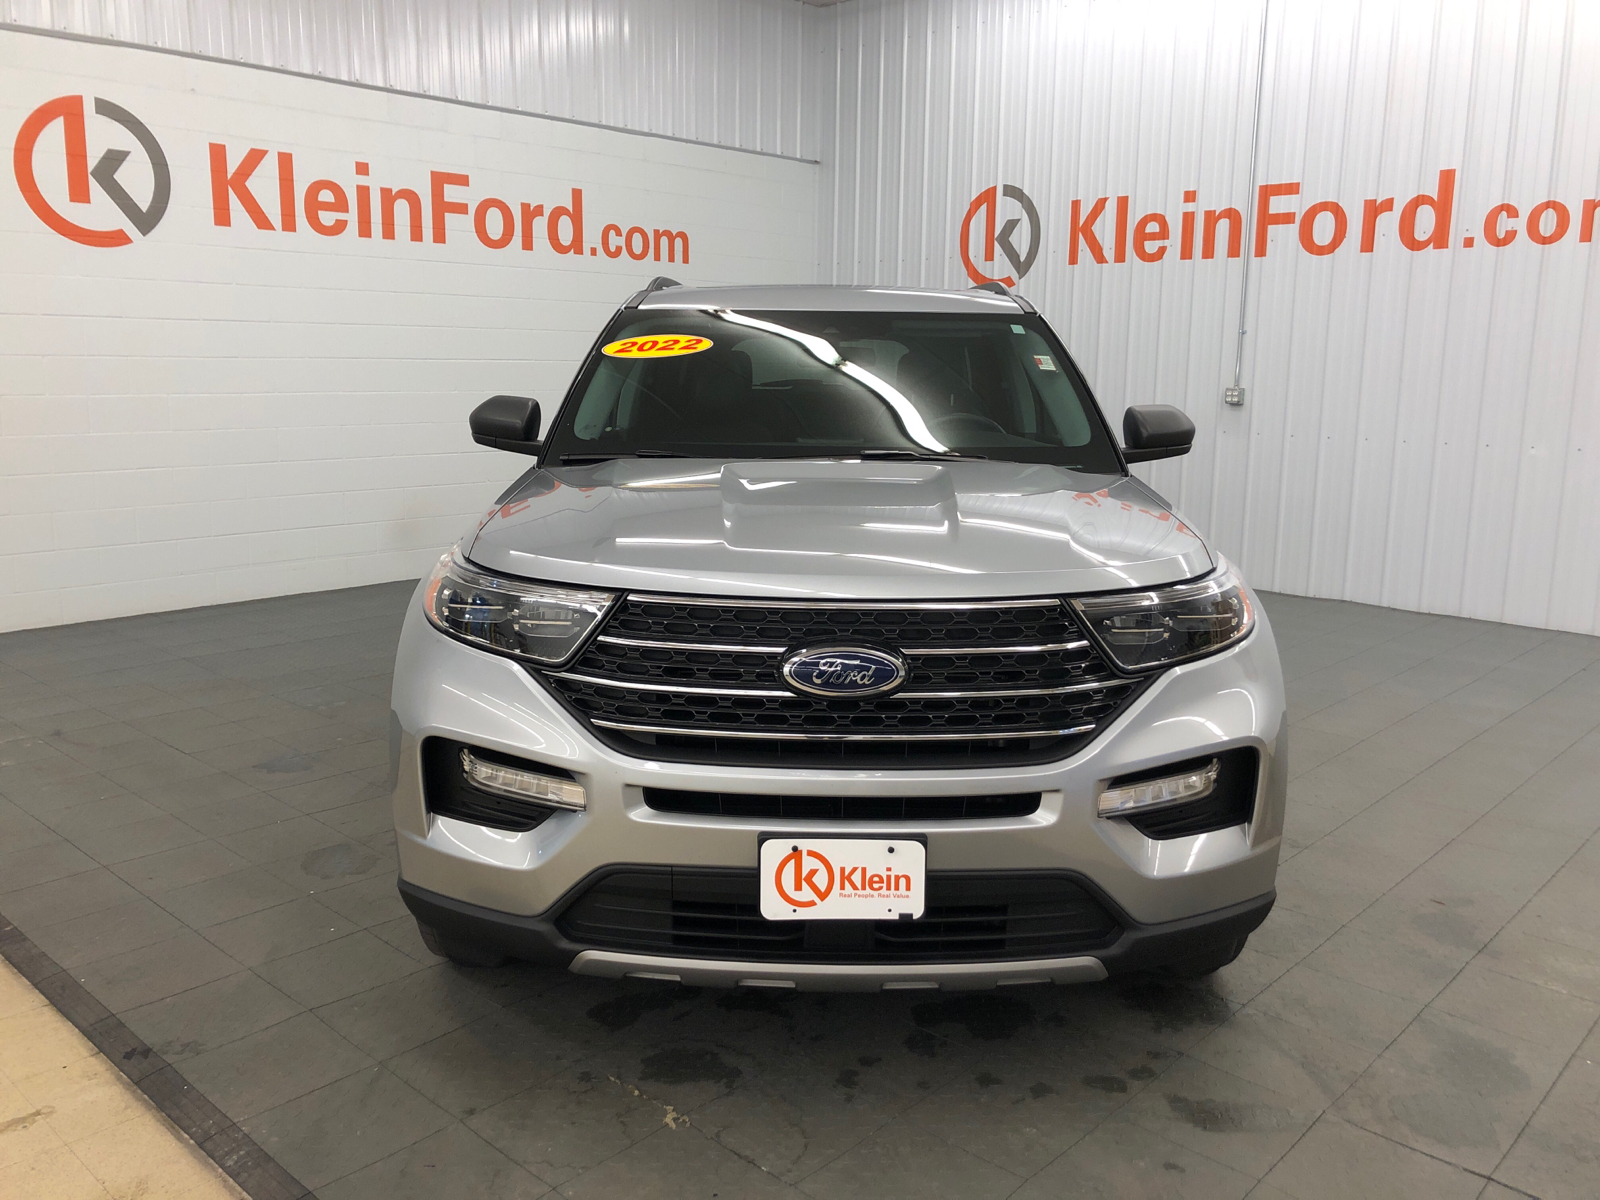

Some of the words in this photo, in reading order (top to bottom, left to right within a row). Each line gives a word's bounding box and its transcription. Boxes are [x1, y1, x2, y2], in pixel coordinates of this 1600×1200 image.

[208, 142, 690, 265] KleinFord.com
[613, 338, 704, 354] 2022
[812, 658, 875, 685] Ford
[839, 866, 912, 892] Klein
